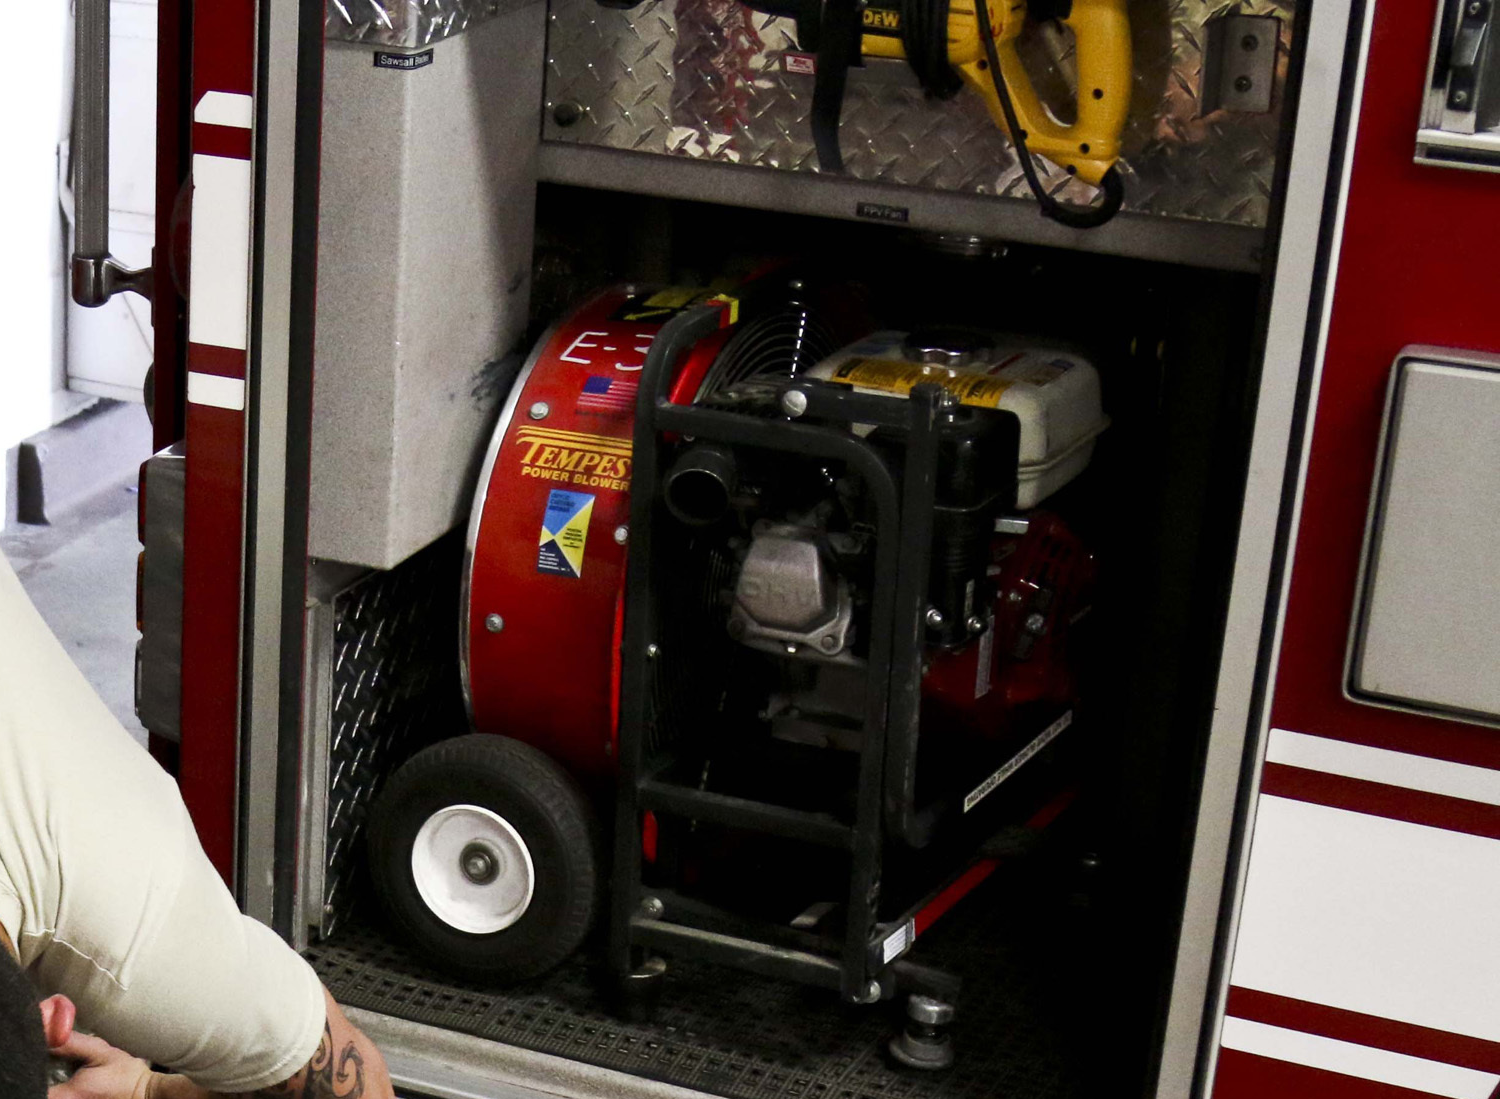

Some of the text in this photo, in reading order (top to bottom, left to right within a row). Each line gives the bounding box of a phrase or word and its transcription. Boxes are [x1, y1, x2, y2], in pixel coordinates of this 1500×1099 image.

[863, 9, 899, 27] DEW
[380, 55, 414, 67] Sawsall
[516, 436, 633, 481] TEMPES
[521, 465, 630, 491] POWER BLOWER
